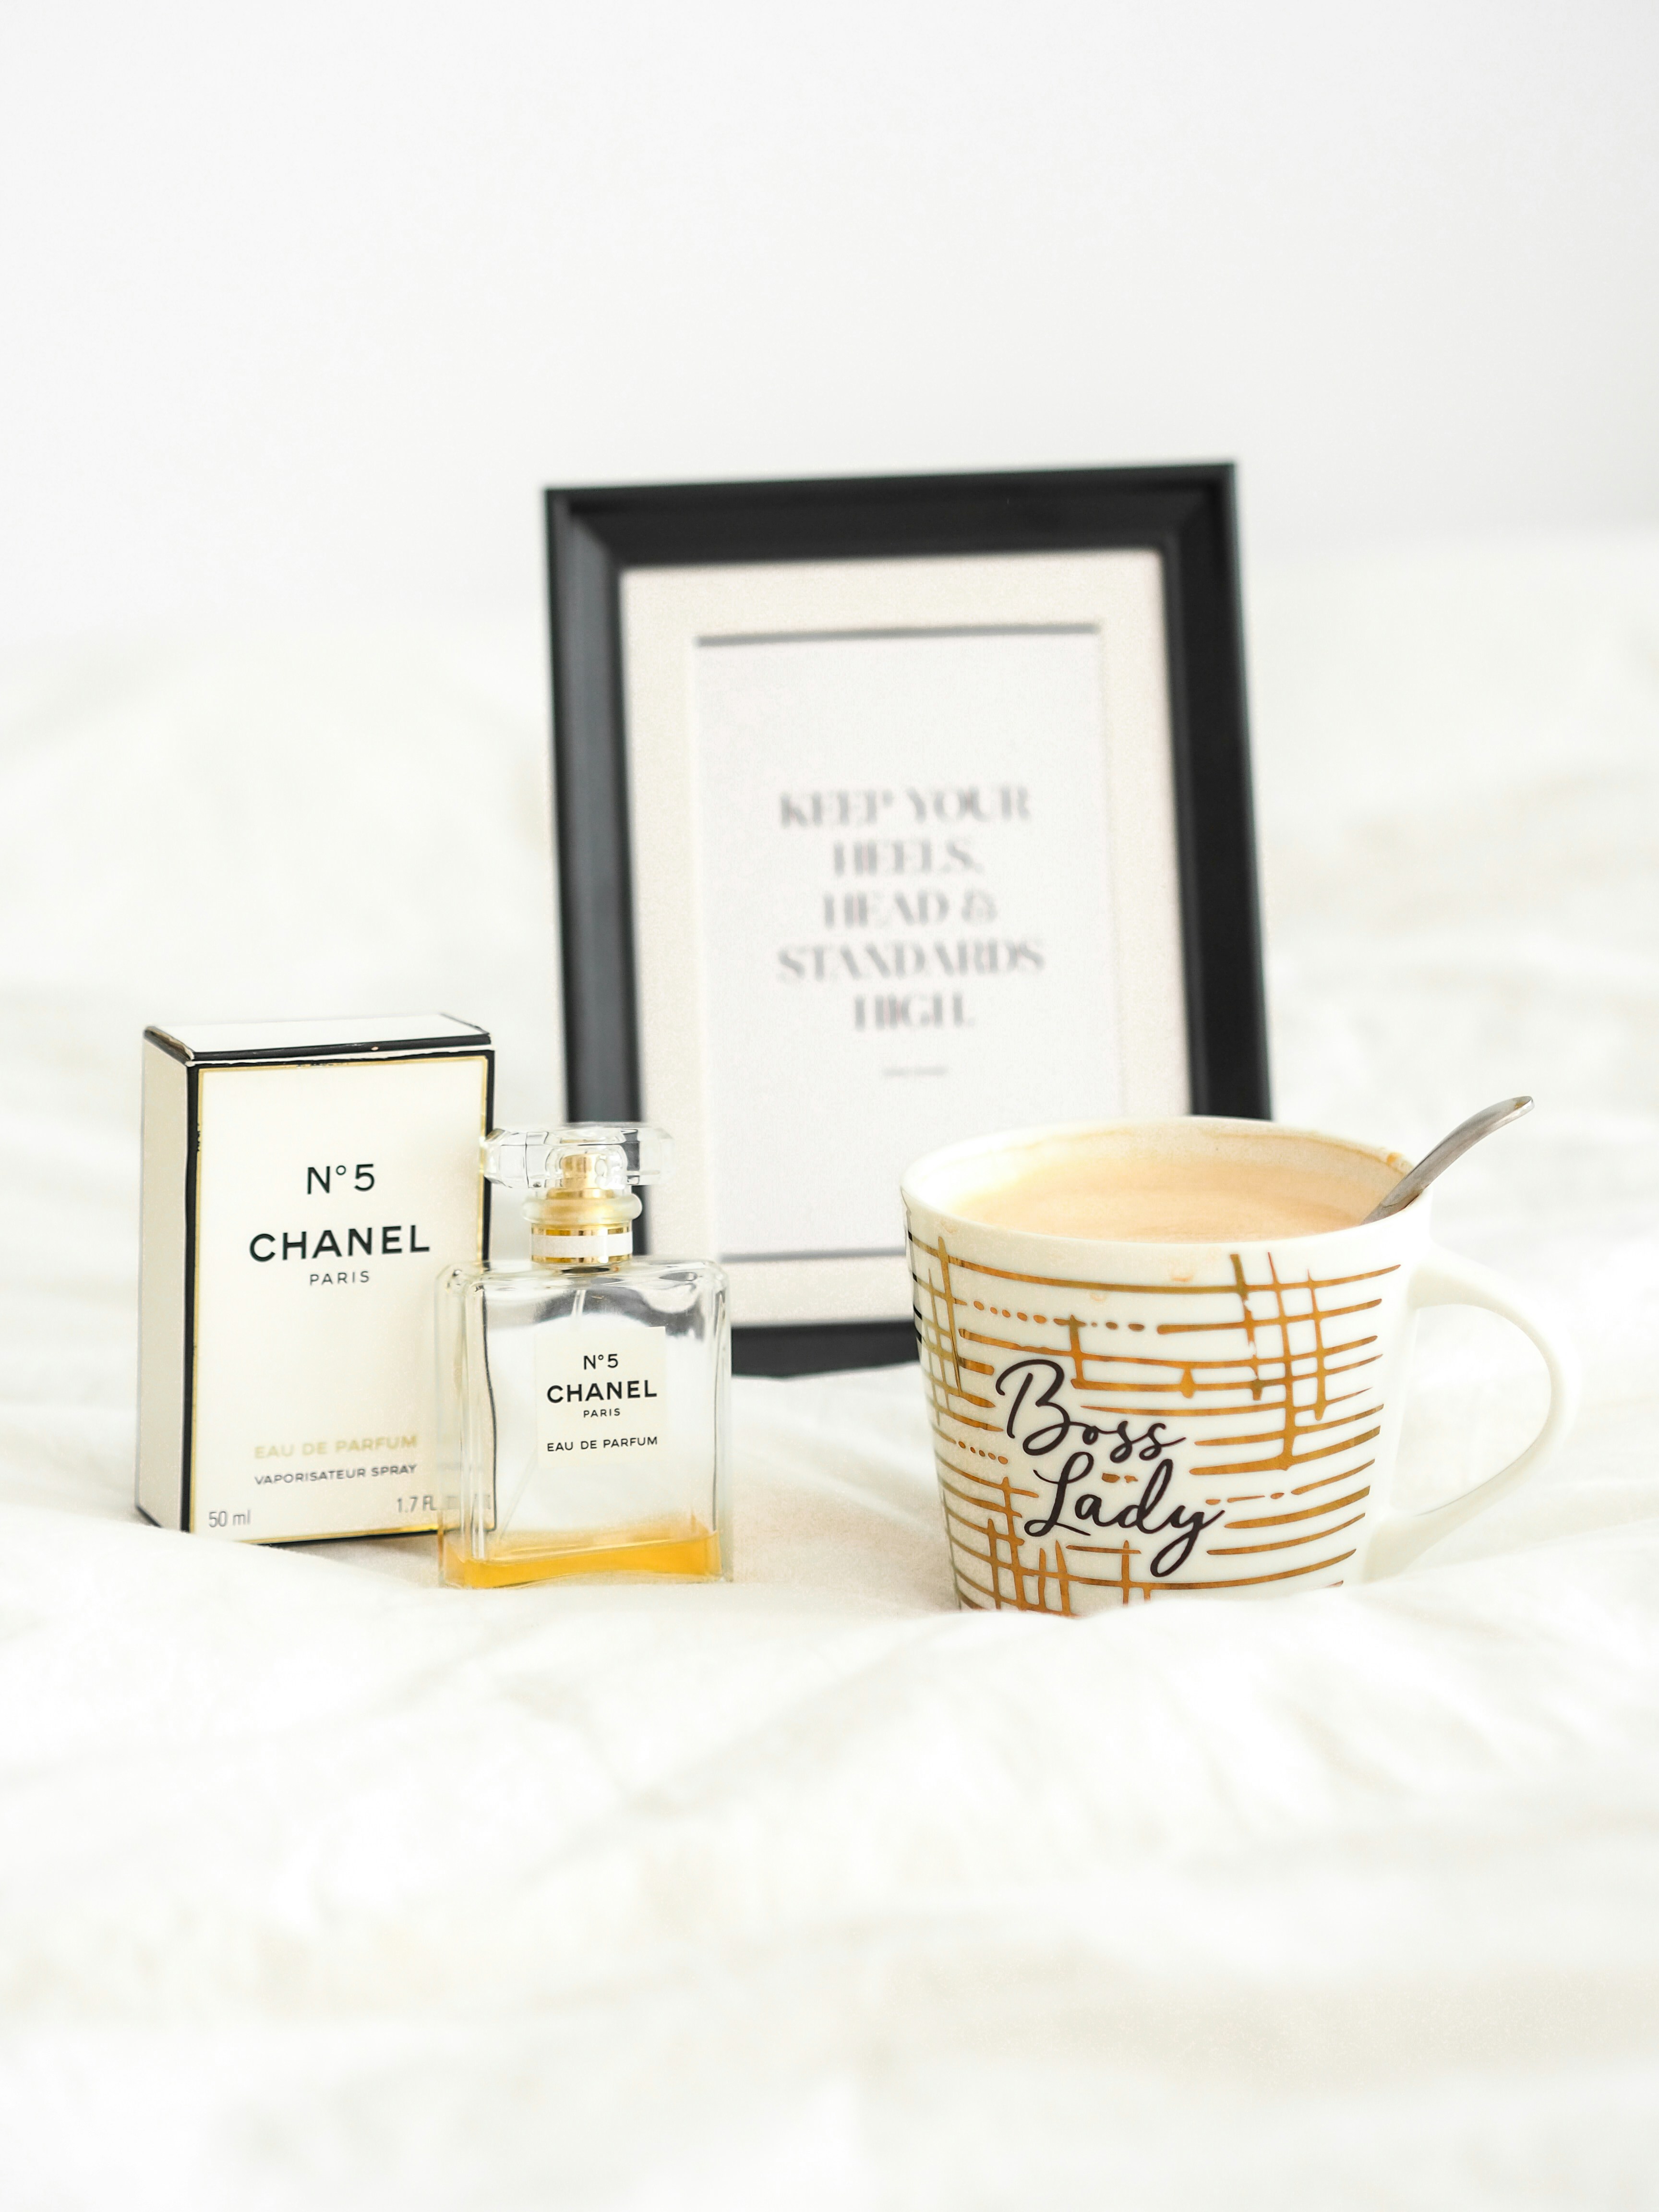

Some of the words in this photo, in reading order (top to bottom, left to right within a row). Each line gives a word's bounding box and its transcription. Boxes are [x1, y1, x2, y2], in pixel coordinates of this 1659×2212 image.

[779, 791, 894, 828] KEEP
[906, 785, 1032, 824] YOUR
[823, 889, 950, 929] HEAD
[961, 889, 998, 925] &
[777, 937, 1046, 982] STANDARDS
[249, 1225, 430, 1262] CHANEL
[310, 1270, 370, 1285] PARIS
[547, 1380, 657, 1403] CHANEL
[583, 1408, 620, 1418] PARIS
[995, 1359, 1186, 1463] Boss
[254, 1444, 294, 1459] EAU
[302, 1442, 327, 1456] DE
[335, 1435, 417, 1452] PARFUM
[547, 1442, 573, 1451] EAU
[581, 1440, 597, 1449] DE
[603, 1436, 657, 1448] PARFUM
[254, 1468, 365, 1485] VAPORISATEUR
[371, 1464, 417, 1477] SPRAY
[397, 1496, 418, 1513] 1.7
[1024, 1451, 1225, 1577] Lady
[208, 1511, 227, 1527] 50
[233, 1510, 251, 1526] ml
